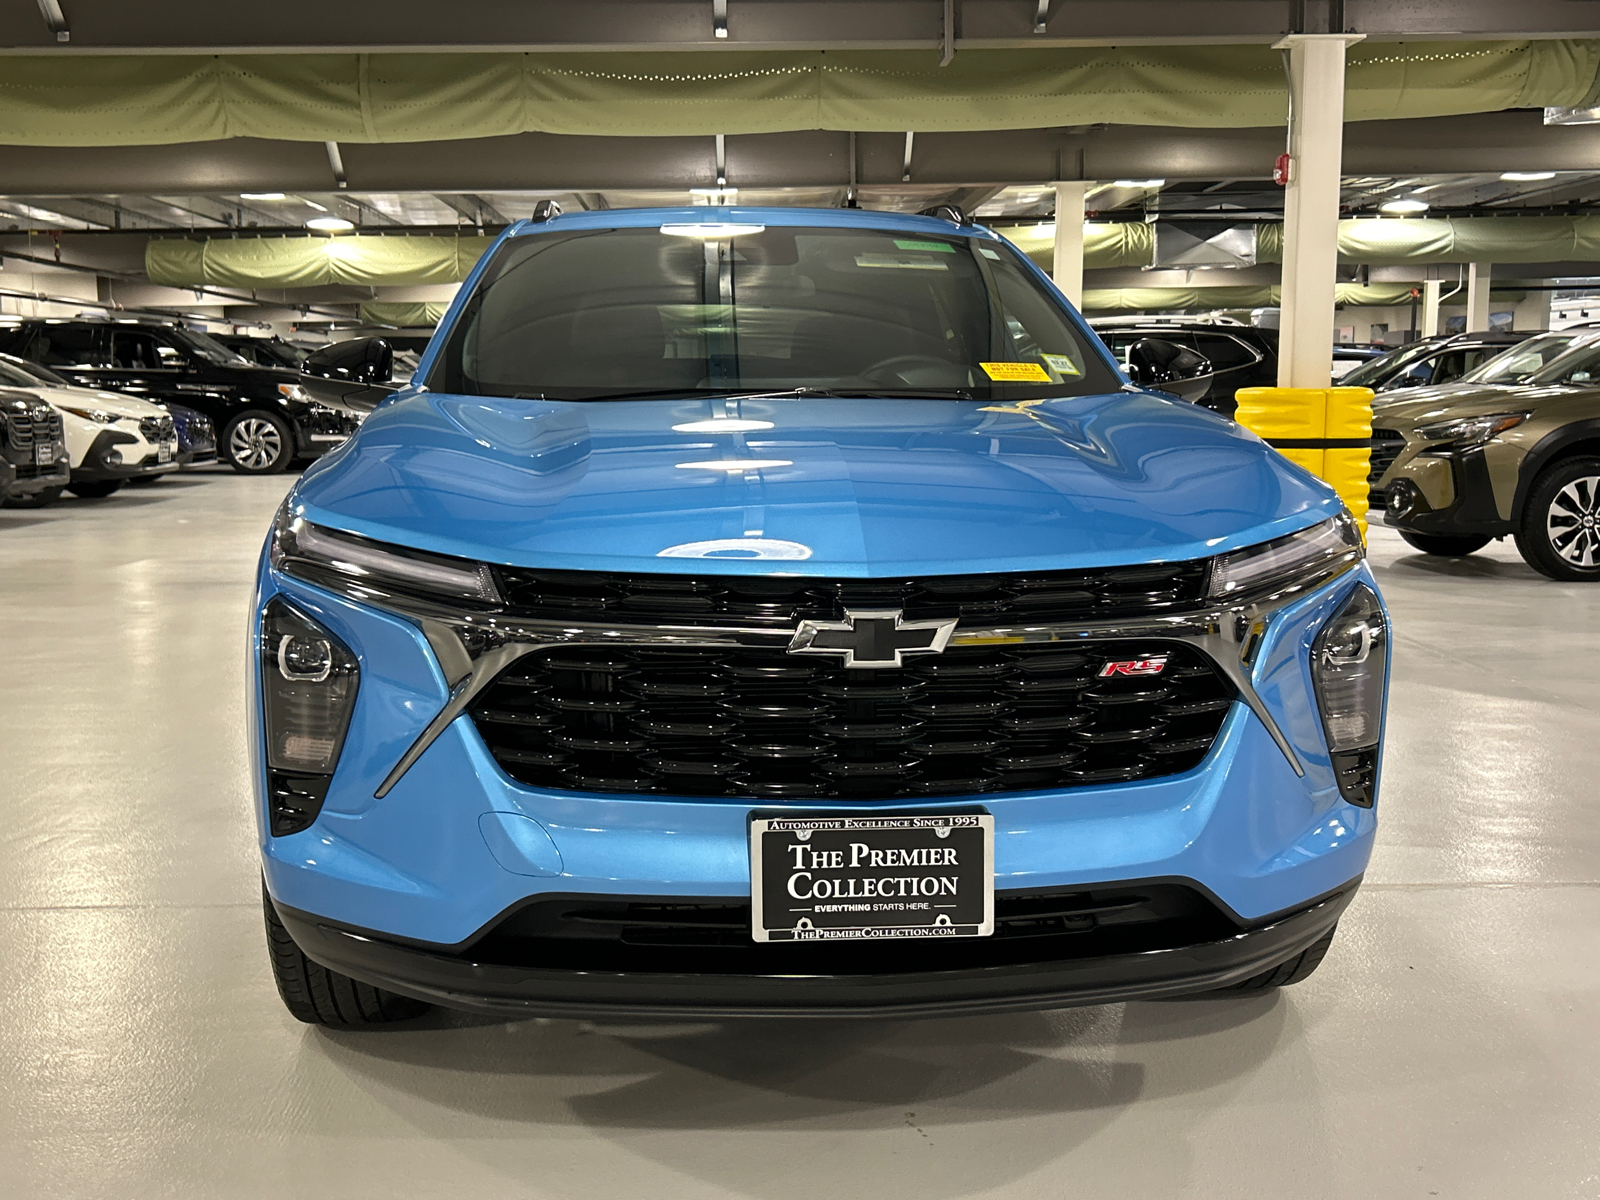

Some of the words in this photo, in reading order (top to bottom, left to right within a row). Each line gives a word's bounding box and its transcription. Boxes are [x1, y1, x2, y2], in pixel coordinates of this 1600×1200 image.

[1099, 659, 1168, 676] RS
[770, 821, 841, 830] AUTOMOTIVE
[844, 819, 910, 829] EXCELLENCE
[913, 818, 945, 827] SINCE
[948, 816, 977, 826] 1995
[787, 844, 844, 869] THE
[848, 843, 959, 867] PREMIER
[787, 872, 959, 900] COLLECTION
[814, 904, 871, 913] EVERYTHING
[872, 903, 904, 911] STARTS
[906, 902, 931, 910] HERE.
[791, 927, 956, 940] THEPREMIERCOLLECTION.COM
